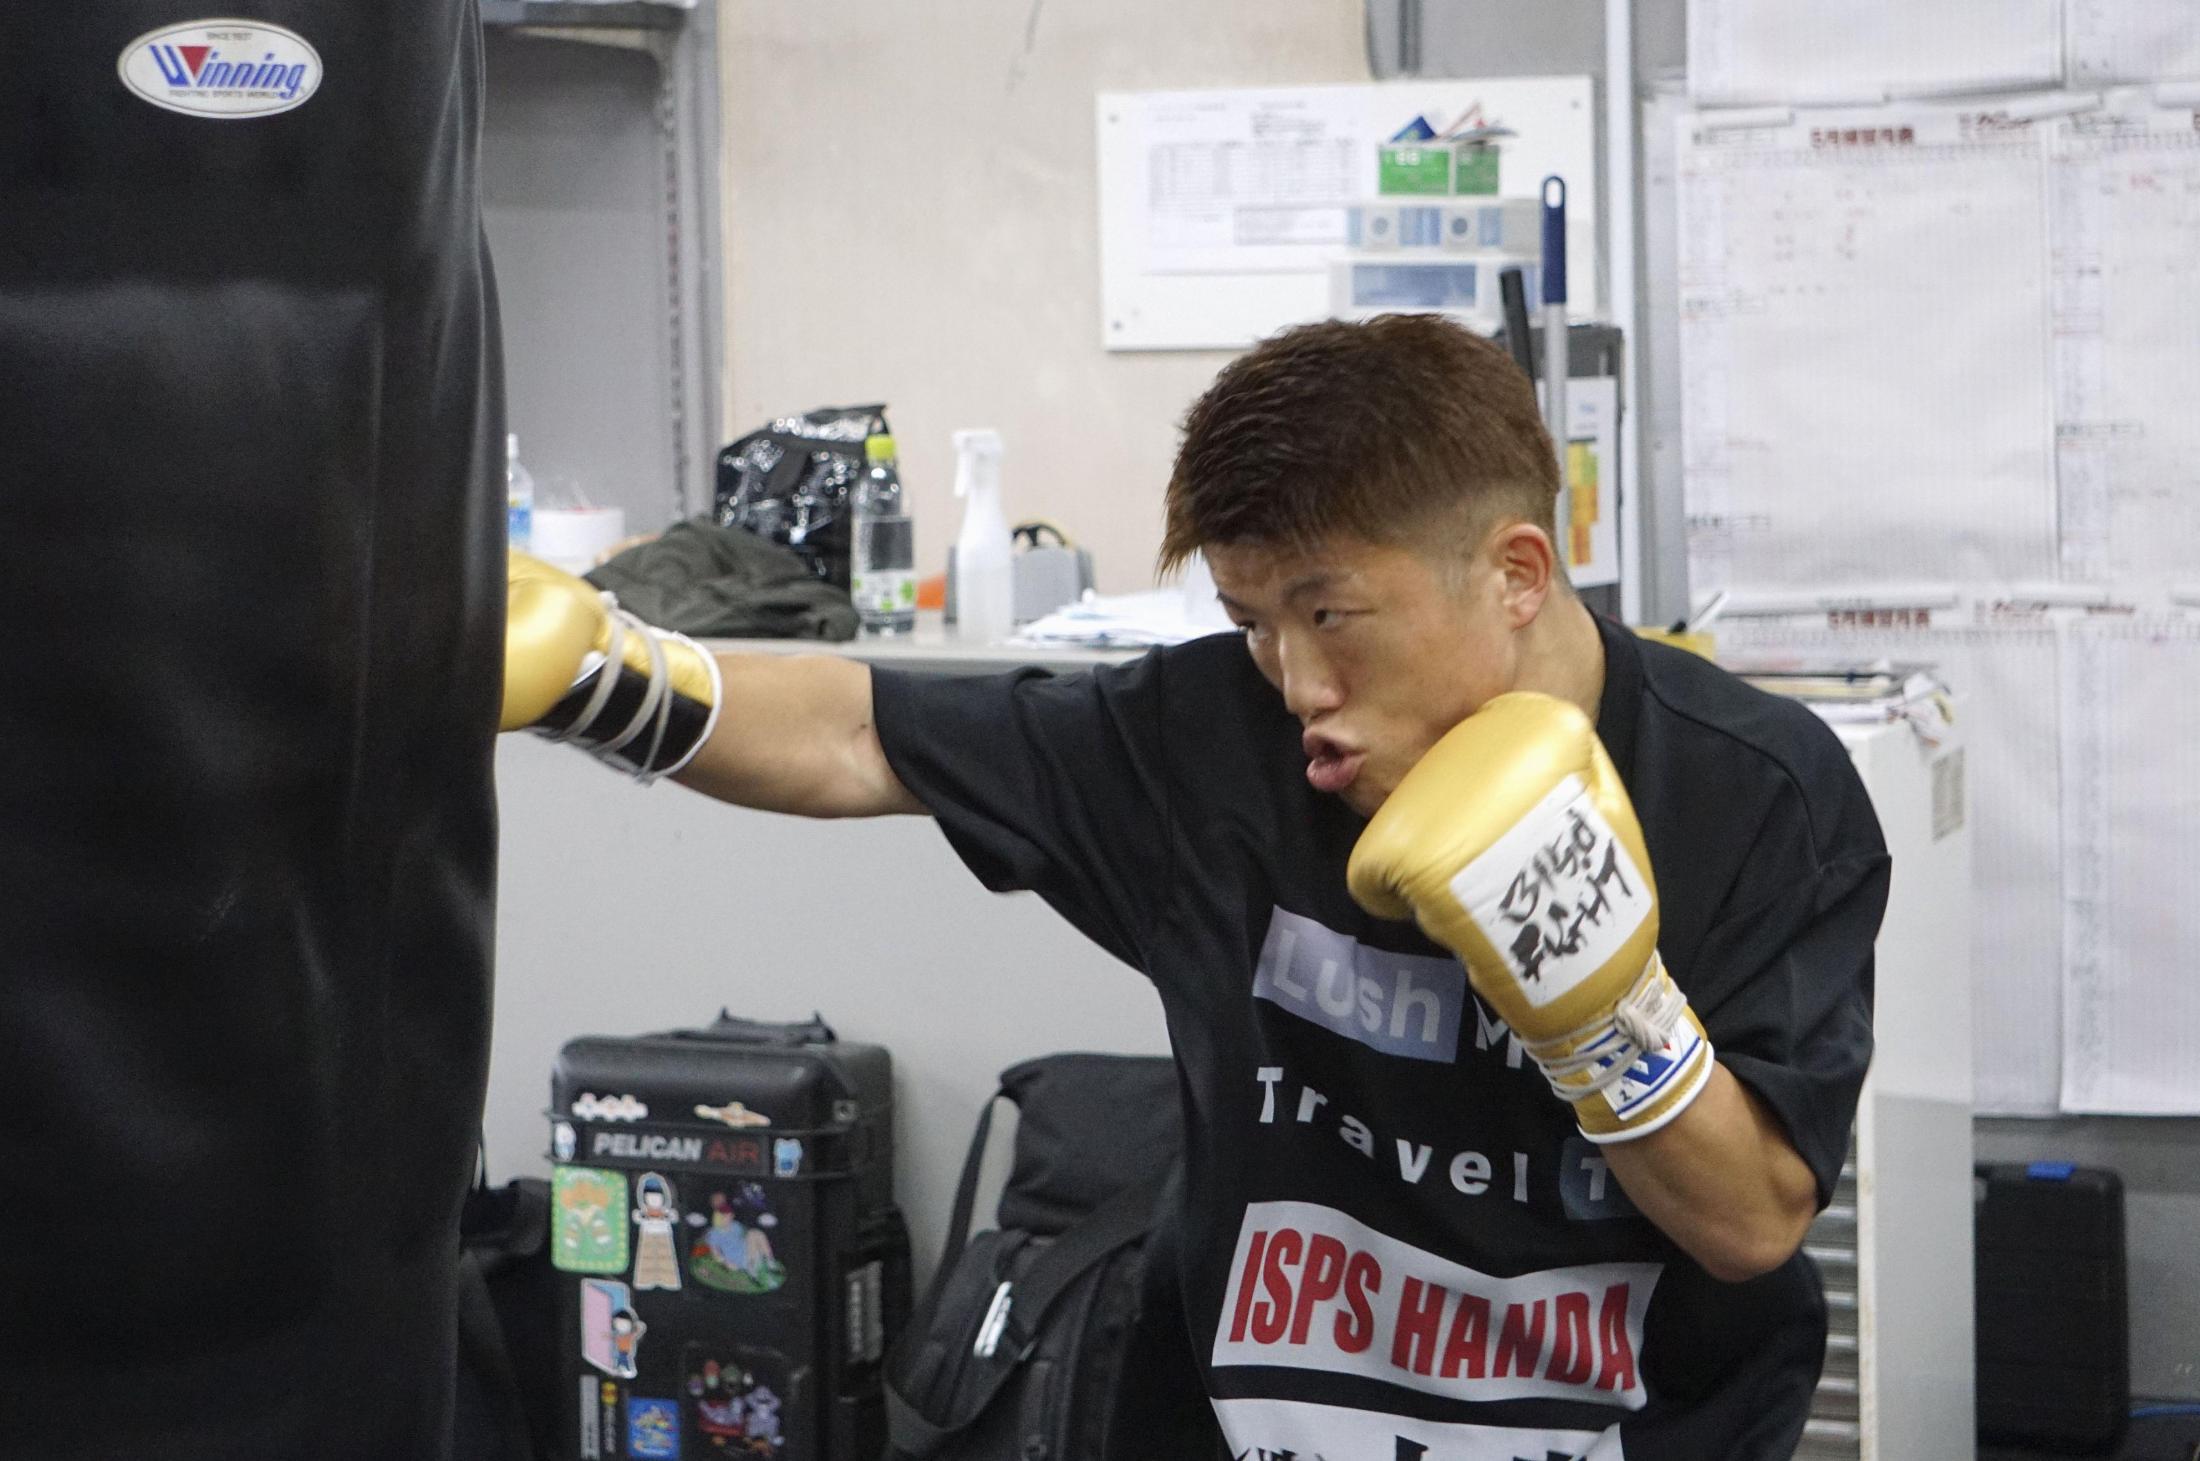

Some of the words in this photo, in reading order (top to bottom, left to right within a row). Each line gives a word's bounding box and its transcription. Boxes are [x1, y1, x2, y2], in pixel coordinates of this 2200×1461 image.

[148, 44, 305, 99] Winning
[1271, 929, 1442, 1043] Lush
[593, 1132, 703, 1162] PELICAN
[707, 1140, 760, 1162] AIR
[1256, 1066, 1529, 1203] Travel
[1229, 1228, 1382, 1355] ISPS
[1390, 1274, 1637, 1393] HANDA
